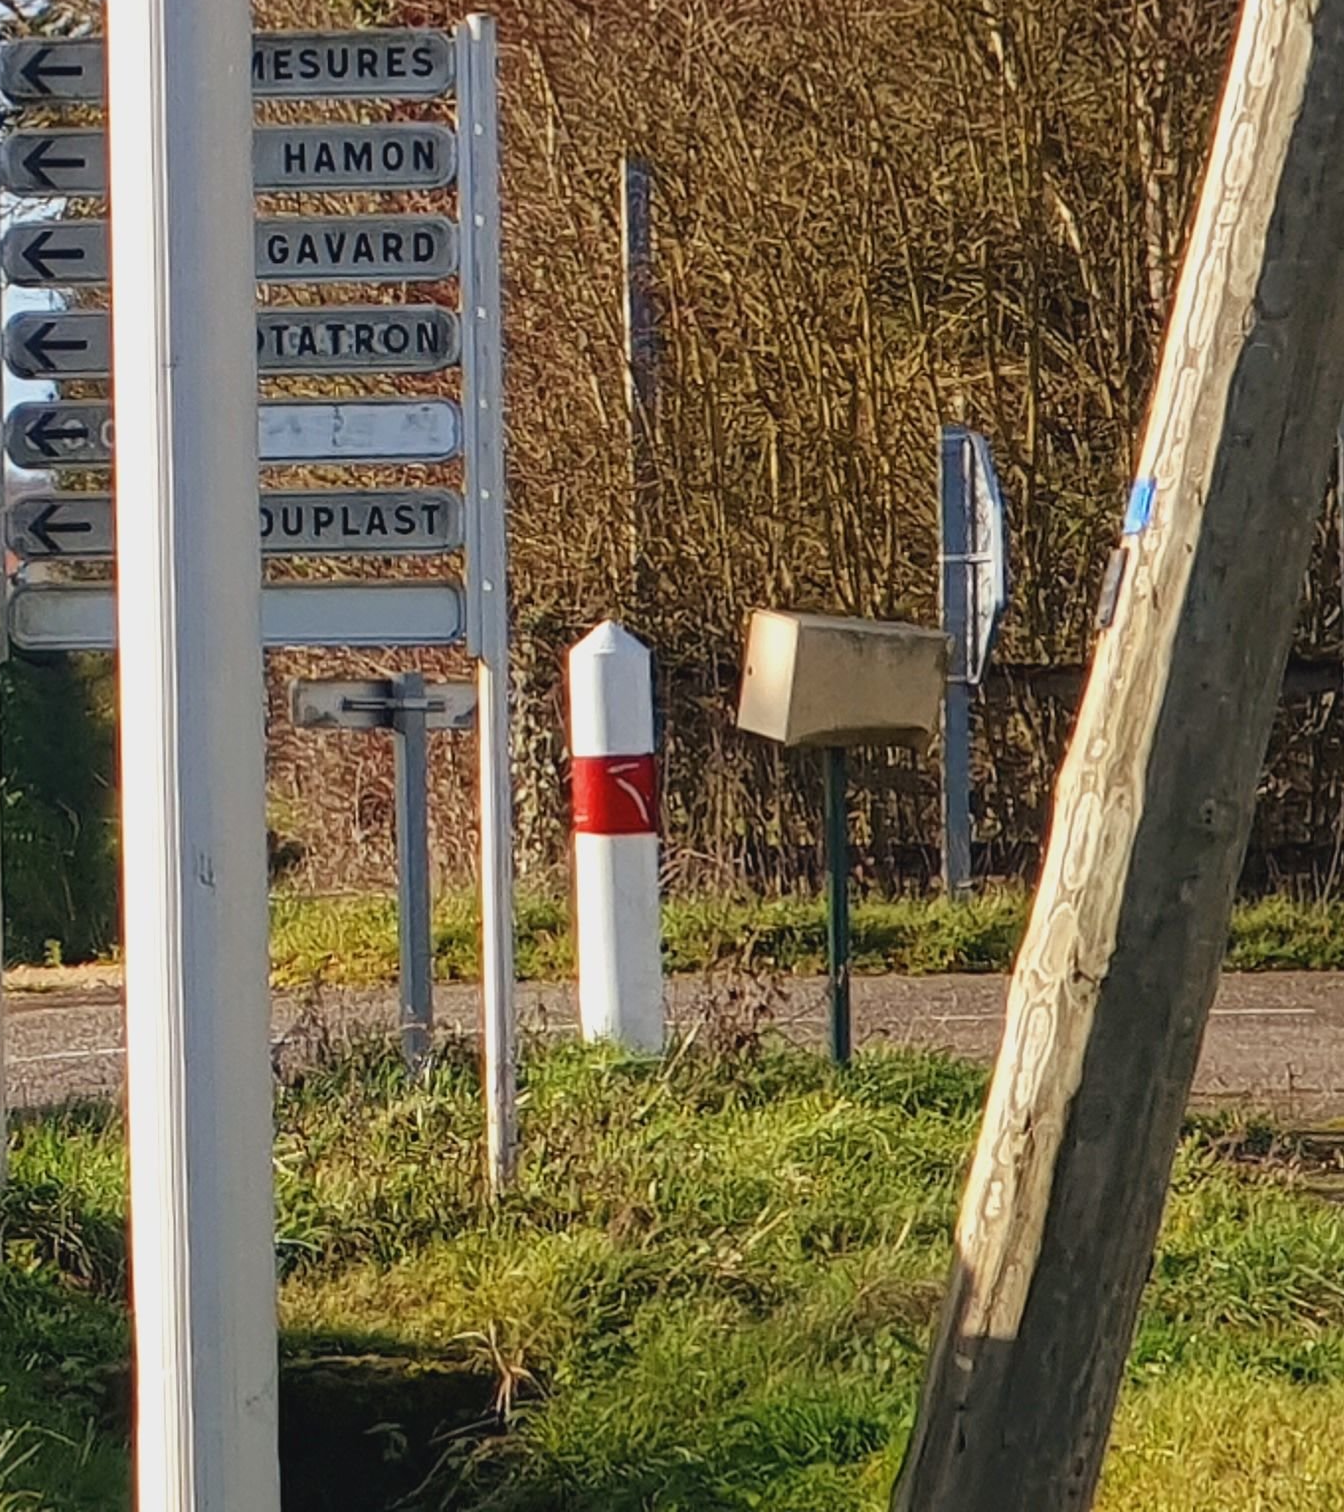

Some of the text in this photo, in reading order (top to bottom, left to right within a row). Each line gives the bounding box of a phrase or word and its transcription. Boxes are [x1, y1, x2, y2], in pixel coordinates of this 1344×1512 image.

[284, 141, 435, 174] HAMON
[267, 232, 434, 265] GAVARD
[256, 323, 439, 356] TATRON
